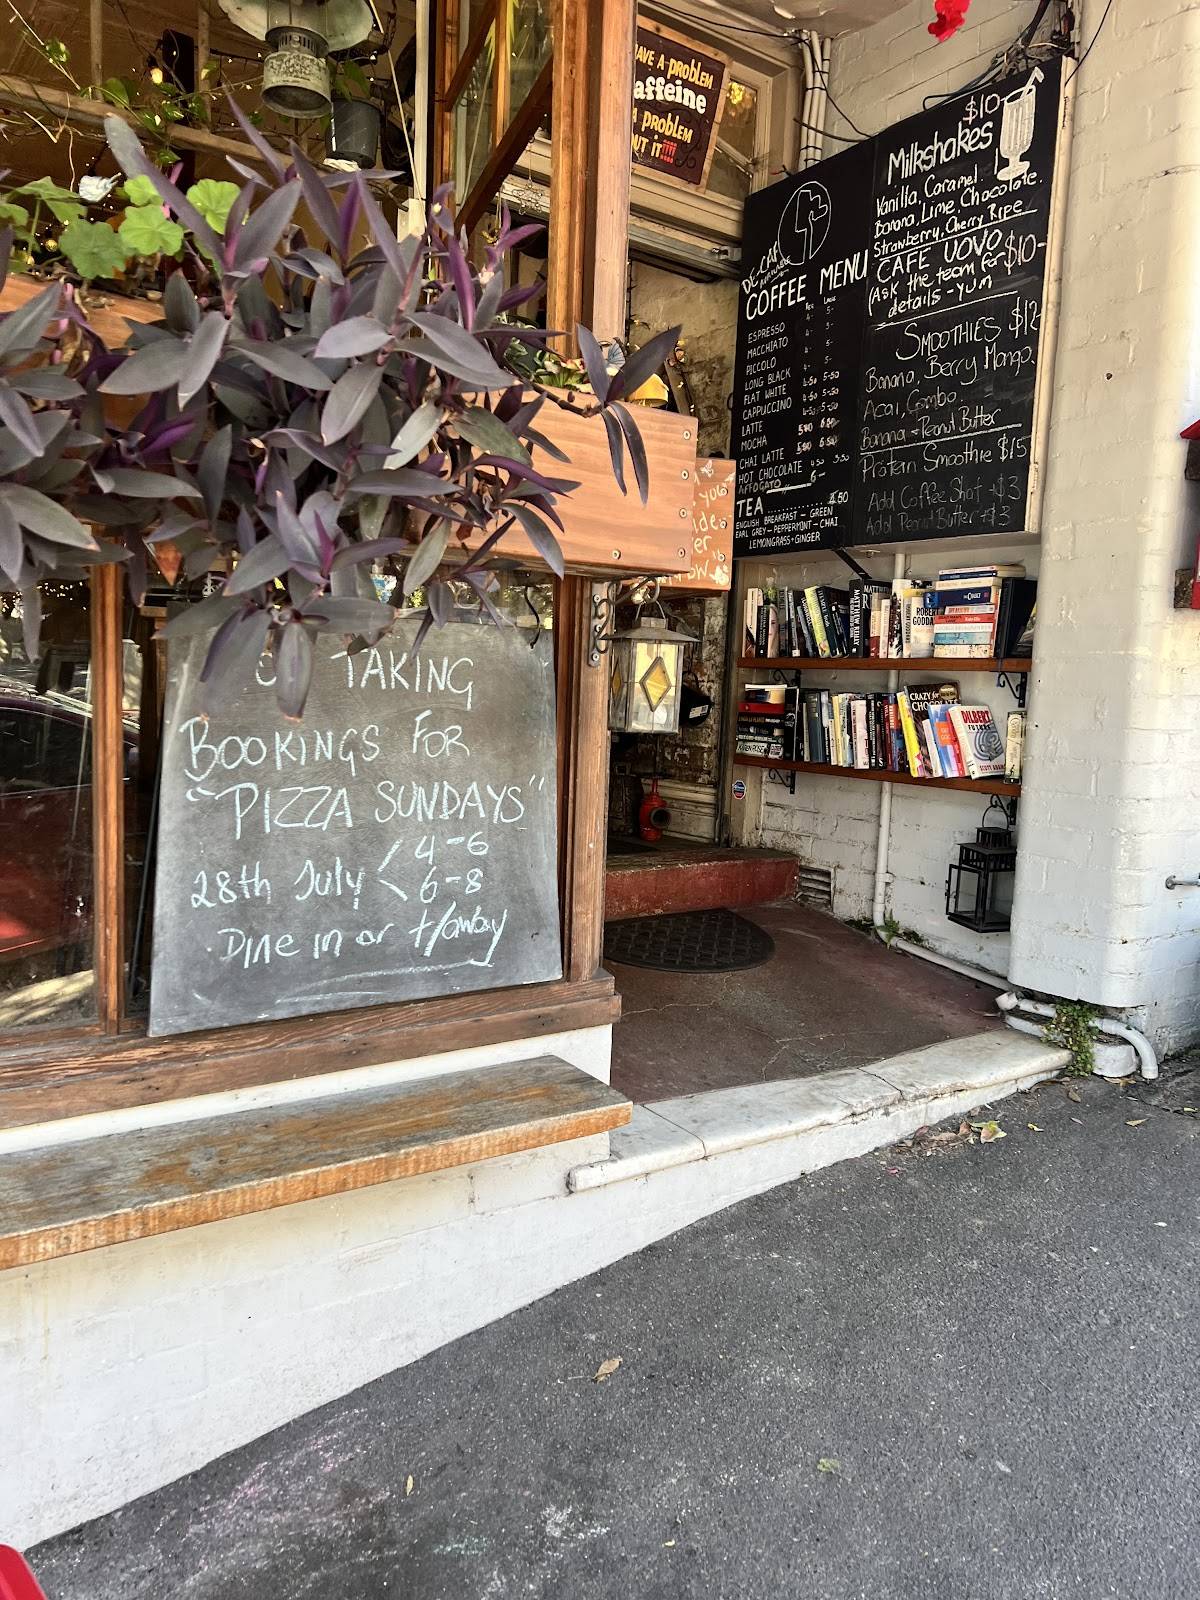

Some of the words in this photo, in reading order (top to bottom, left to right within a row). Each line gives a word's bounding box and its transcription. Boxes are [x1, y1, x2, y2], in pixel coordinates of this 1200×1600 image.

[635, 44, 655, 66] AVE
[657, 54, 665, 70] A
[633, 76, 707, 115] affeine
[631, 133, 649, 153] UT
[887, 119, 994, 186] Milkshakes
[945, 214, 985, 236] Cherry
[876, 247, 932, 284] CAFE
[943, 228, 1003, 264] UOVO
[745, 274, 808, 321] COFFEE
[819, 249, 869, 295] MENU
[907, 271, 935, 294] the
[936, 260, 976, 285] team
[981, 251, 1006, 272] for
[887, 287, 942, 318] details
[747, 321, 786, 344] ESPRESSO
[895, 316, 1001, 360] SMOOTHIES
[746, 336, 789, 360] MACCHIATO
[746, 356, 777, 376] PICCOLO
[923, 354, 978, 386] Berry
[744, 376, 764, 392] LONG
[767, 367, 792, 385] BLACK
[743, 391, 761, 406] FLAT
[765, 383, 787, 400] WHITE
[742, 396, 793, 421] CAPPUCCINO
[741, 420, 764, 437] LATTE
[859, 426, 907, 451] Banana
[917, 412, 955, 440] Peanut
[957, 405, 1002, 433] Butter
[740, 435, 768, 452] MOCHA
[739, 455, 758, 470] CHAI
[761, 447, 785, 464] LATTE
[859, 446, 917, 484] Protein
[922, 440, 993, 472] Smoothie
[738, 470, 754, 485] HOT
[758, 460, 803, 481] CHOCOLATE
[738, 478, 782, 495] AFFOGATO
[867, 489, 896, 513] Add
[899, 481, 948, 510] Coffee
[948, 475, 984, 503] Shot
[735, 518, 760, 531] ENGLISH
[763, 510, 798, 525] BREAKFAST
[809, 505, 834, 518] GREEN
[736, 496, 764, 518] TEA
[735, 528, 749, 539] EARL
[819, 516, 839, 528] CHAI
[866, 513, 893, 537] Add
[935, 504, 979, 530] Butter
[912, 616, 936, 627] GODDA
[330, 646, 475, 711] TAKING
[909, 692, 932, 702] CRAZY
[960, 709, 992, 724] DILBERT
[178, 715, 382, 781] BOOKINGS
[411, 708, 471, 759] FOR
[992, 763, 1006, 771] ADAM
[190, 861, 273, 909] 28th
[293, 856, 366, 910] July
[216, 927, 301, 969] Dine
[312, 929, 342, 960] in
[355, 922, 395, 947] or
